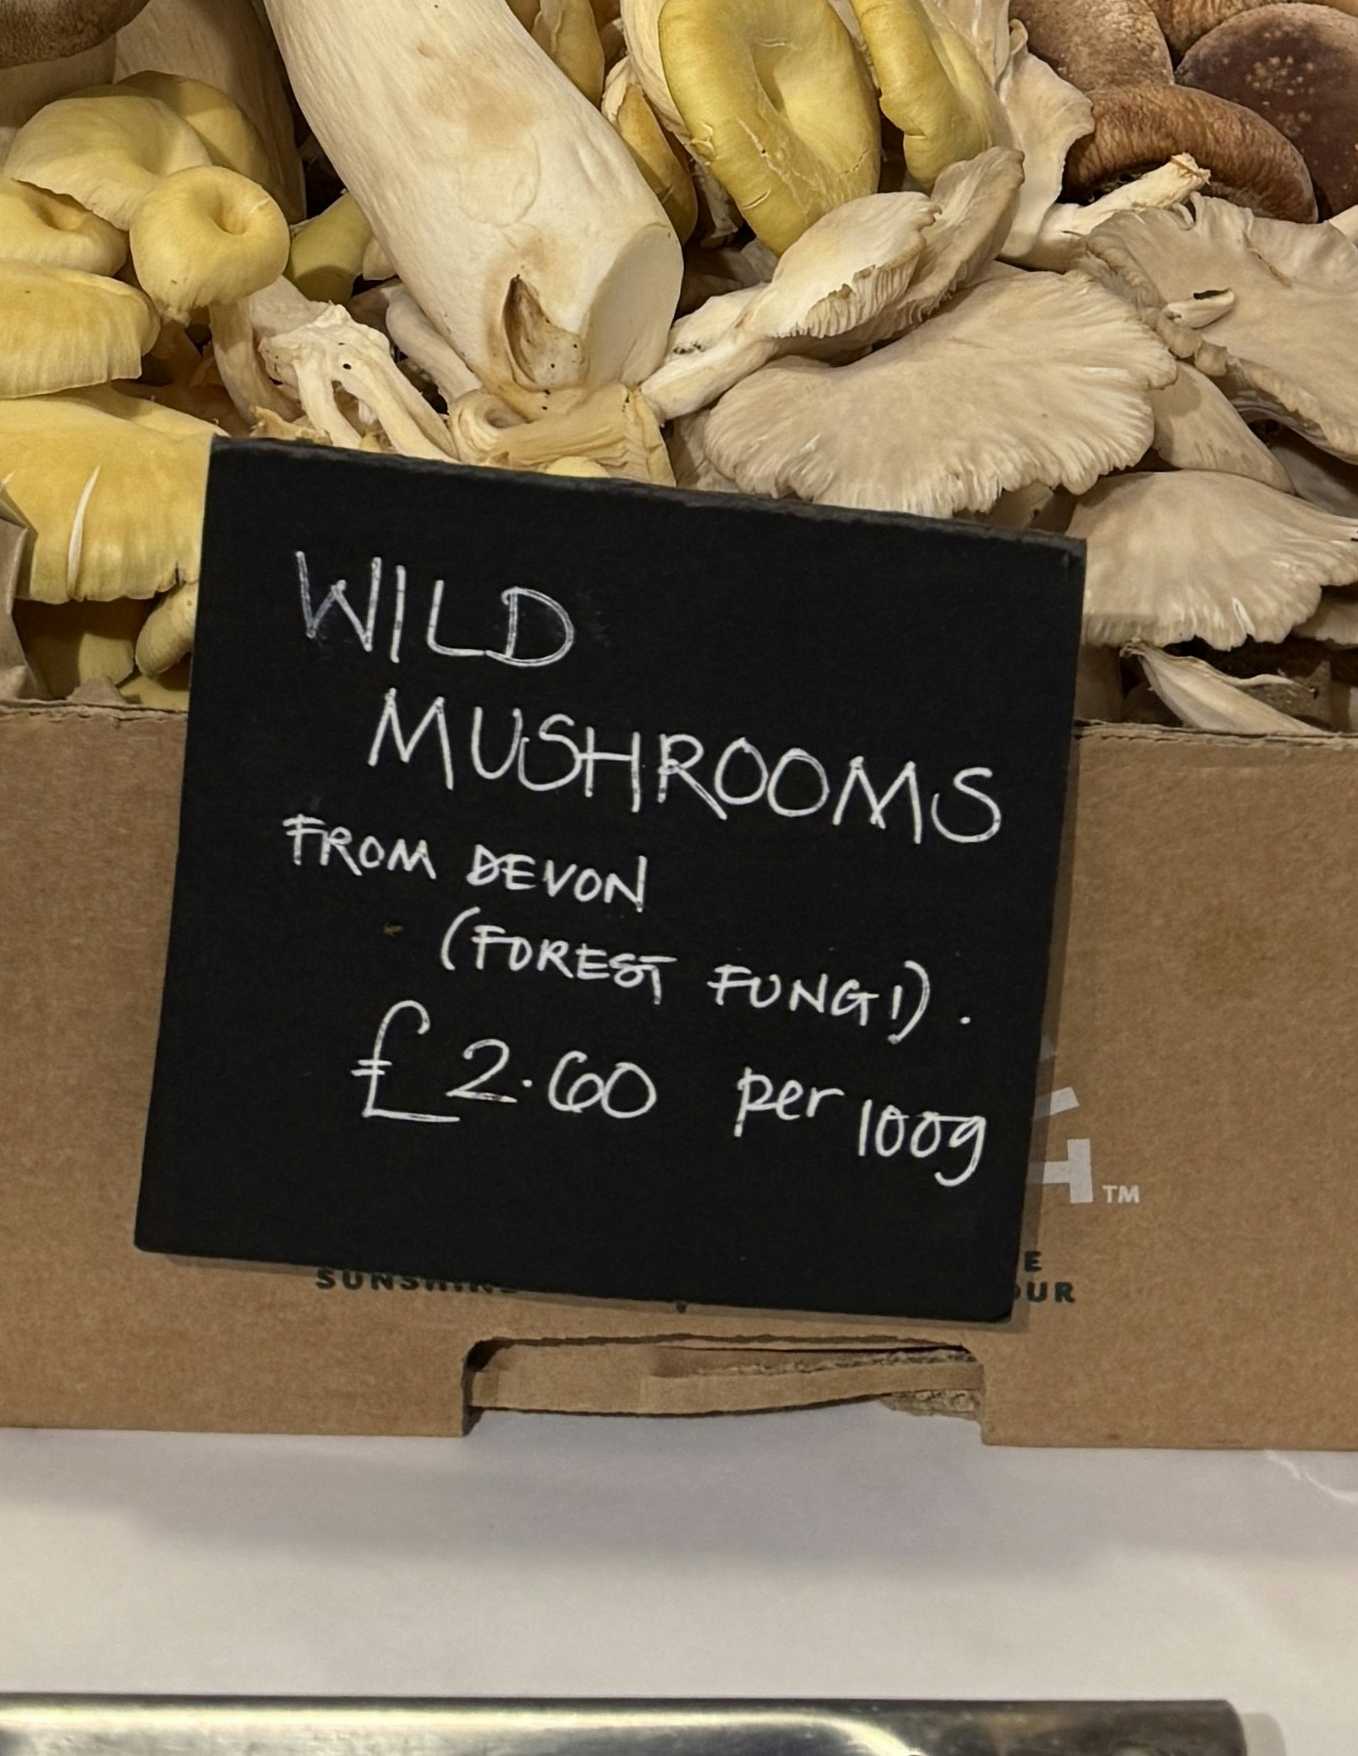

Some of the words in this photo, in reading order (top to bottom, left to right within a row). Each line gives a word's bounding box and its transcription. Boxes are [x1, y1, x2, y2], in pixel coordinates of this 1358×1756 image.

[295, 549, 576, 669] WILD
[367, 686, 1003, 845] MUSHROOMS
[283, 812, 437, 882] FROM
[466, 845, 647, 912] DEVON
[439, 905, 676, 1005] (FOREST
[734, 1066, 844, 1139] per
[855, 1097, 988, 1187] 100g
[1101, 1184, 1141, 1205] TM
